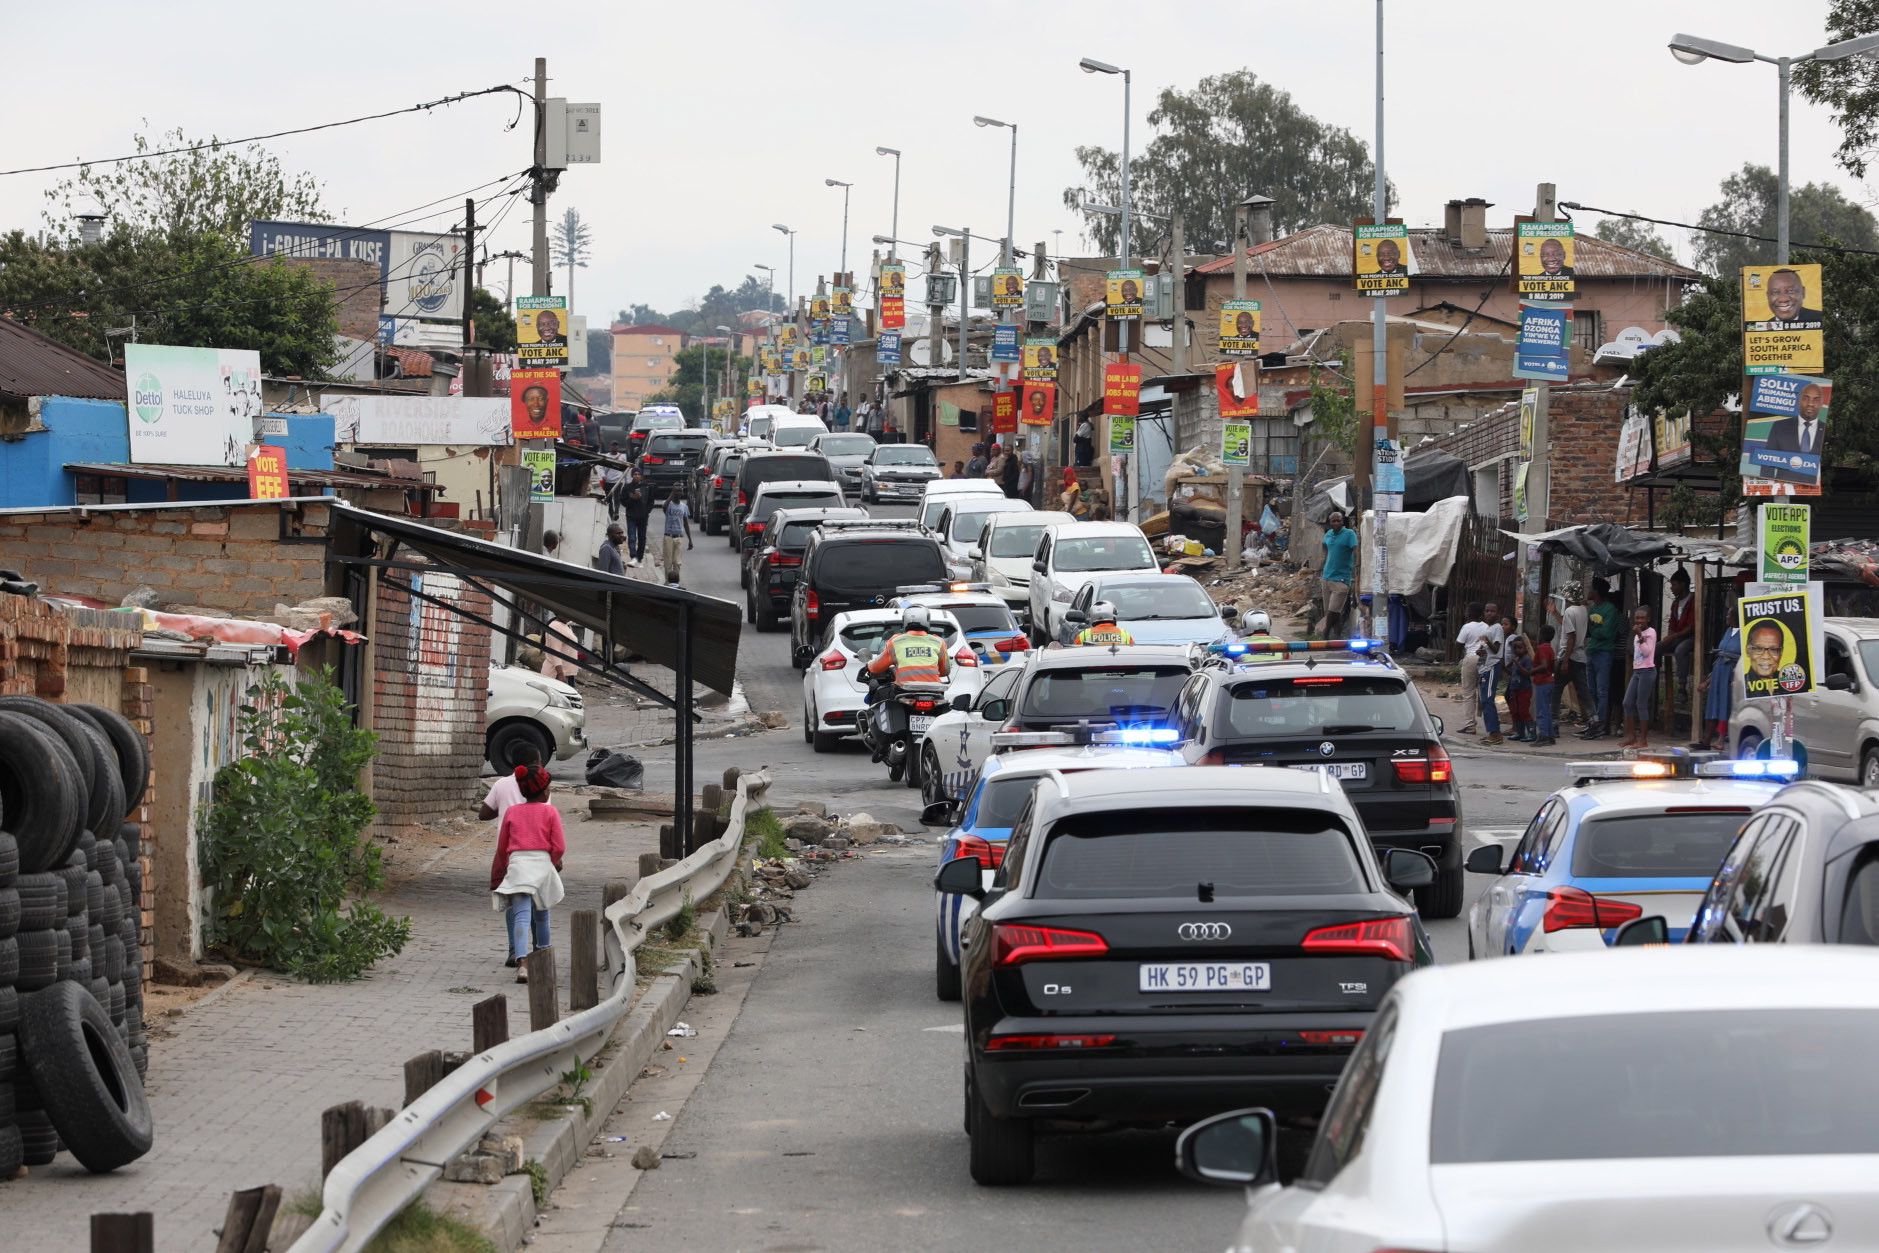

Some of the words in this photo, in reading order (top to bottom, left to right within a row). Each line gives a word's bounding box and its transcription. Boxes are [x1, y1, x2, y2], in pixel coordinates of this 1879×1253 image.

[1359, 225, 1404, 233] RAMAPHOSA
[1360, 280, 1382, 288] VOTE
[1386, 279, 1404, 287] ANC
[1523, 282, 1546, 290] VOTE
[1550, 282, 1569, 290] ANC
[1525, 317, 1560, 327] AFRIKA
[1524, 324, 1560, 334] DZONGA
[1750, 336, 1770, 344] LET'S
[521, 349, 542, 357] VOTE
[546, 348, 563, 356] ANC
[1750, 345, 1778, 353] SOUTH
[1121, 375, 1139, 383] LAND
[1760, 378, 1798, 391] SOLLY
[135, 390, 163, 406] Dettol
[173, 389, 212, 400] HALELUYA
[1122, 389, 1138, 397] NOW
[1758, 388, 1796, 399] MSIMANGA
[1757, 395, 1796, 407] ABENGU
[172, 405, 193, 415] TUCK
[194, 406, 214, 416] SHOP
[375, 399, 462, 419] RIVERSIDE
[996, 404, 1012, 416] EFF
[1112, 416, 1124, 424] VOTE
[381, 421, 452, 442] ROADHOUSE
[1239, 425, 1250, 433] APC
[523, 452, 540, 462] VOTE
[541, 453, 555, 462] APC
[1757, 453, 1788, 464] VOTELA
[1803, 461, 1817, 469] DA
[255, 456, 279, 473] VOTE
[255, 475, 282, 498] EFF
[1765, 507, 1788, 521] VOTE
[1790, 507, 1807, 522] APC
[1771, 525, 1802, 533] ELECTIONS
[1780, 555, 1799, 564] APC
[1745, 601, 1781, 617] TRUST
[1092, 634, 1122, 642] POLICE
[907, 647, 929, 656] POLICE
[1747, 678, 1779, 692] VOTE
[1785, 680, 1801, 689] IFP
[1351, 764, 1364, 777] GP
[1147, 966, 1169, 987] HK
[1177, 966, 1199, 987] 59
[1206, 966, 1228, 987] PG
[1242, 966, 1265, 986] GP
[1044, 984, 1072, 994] Q5
